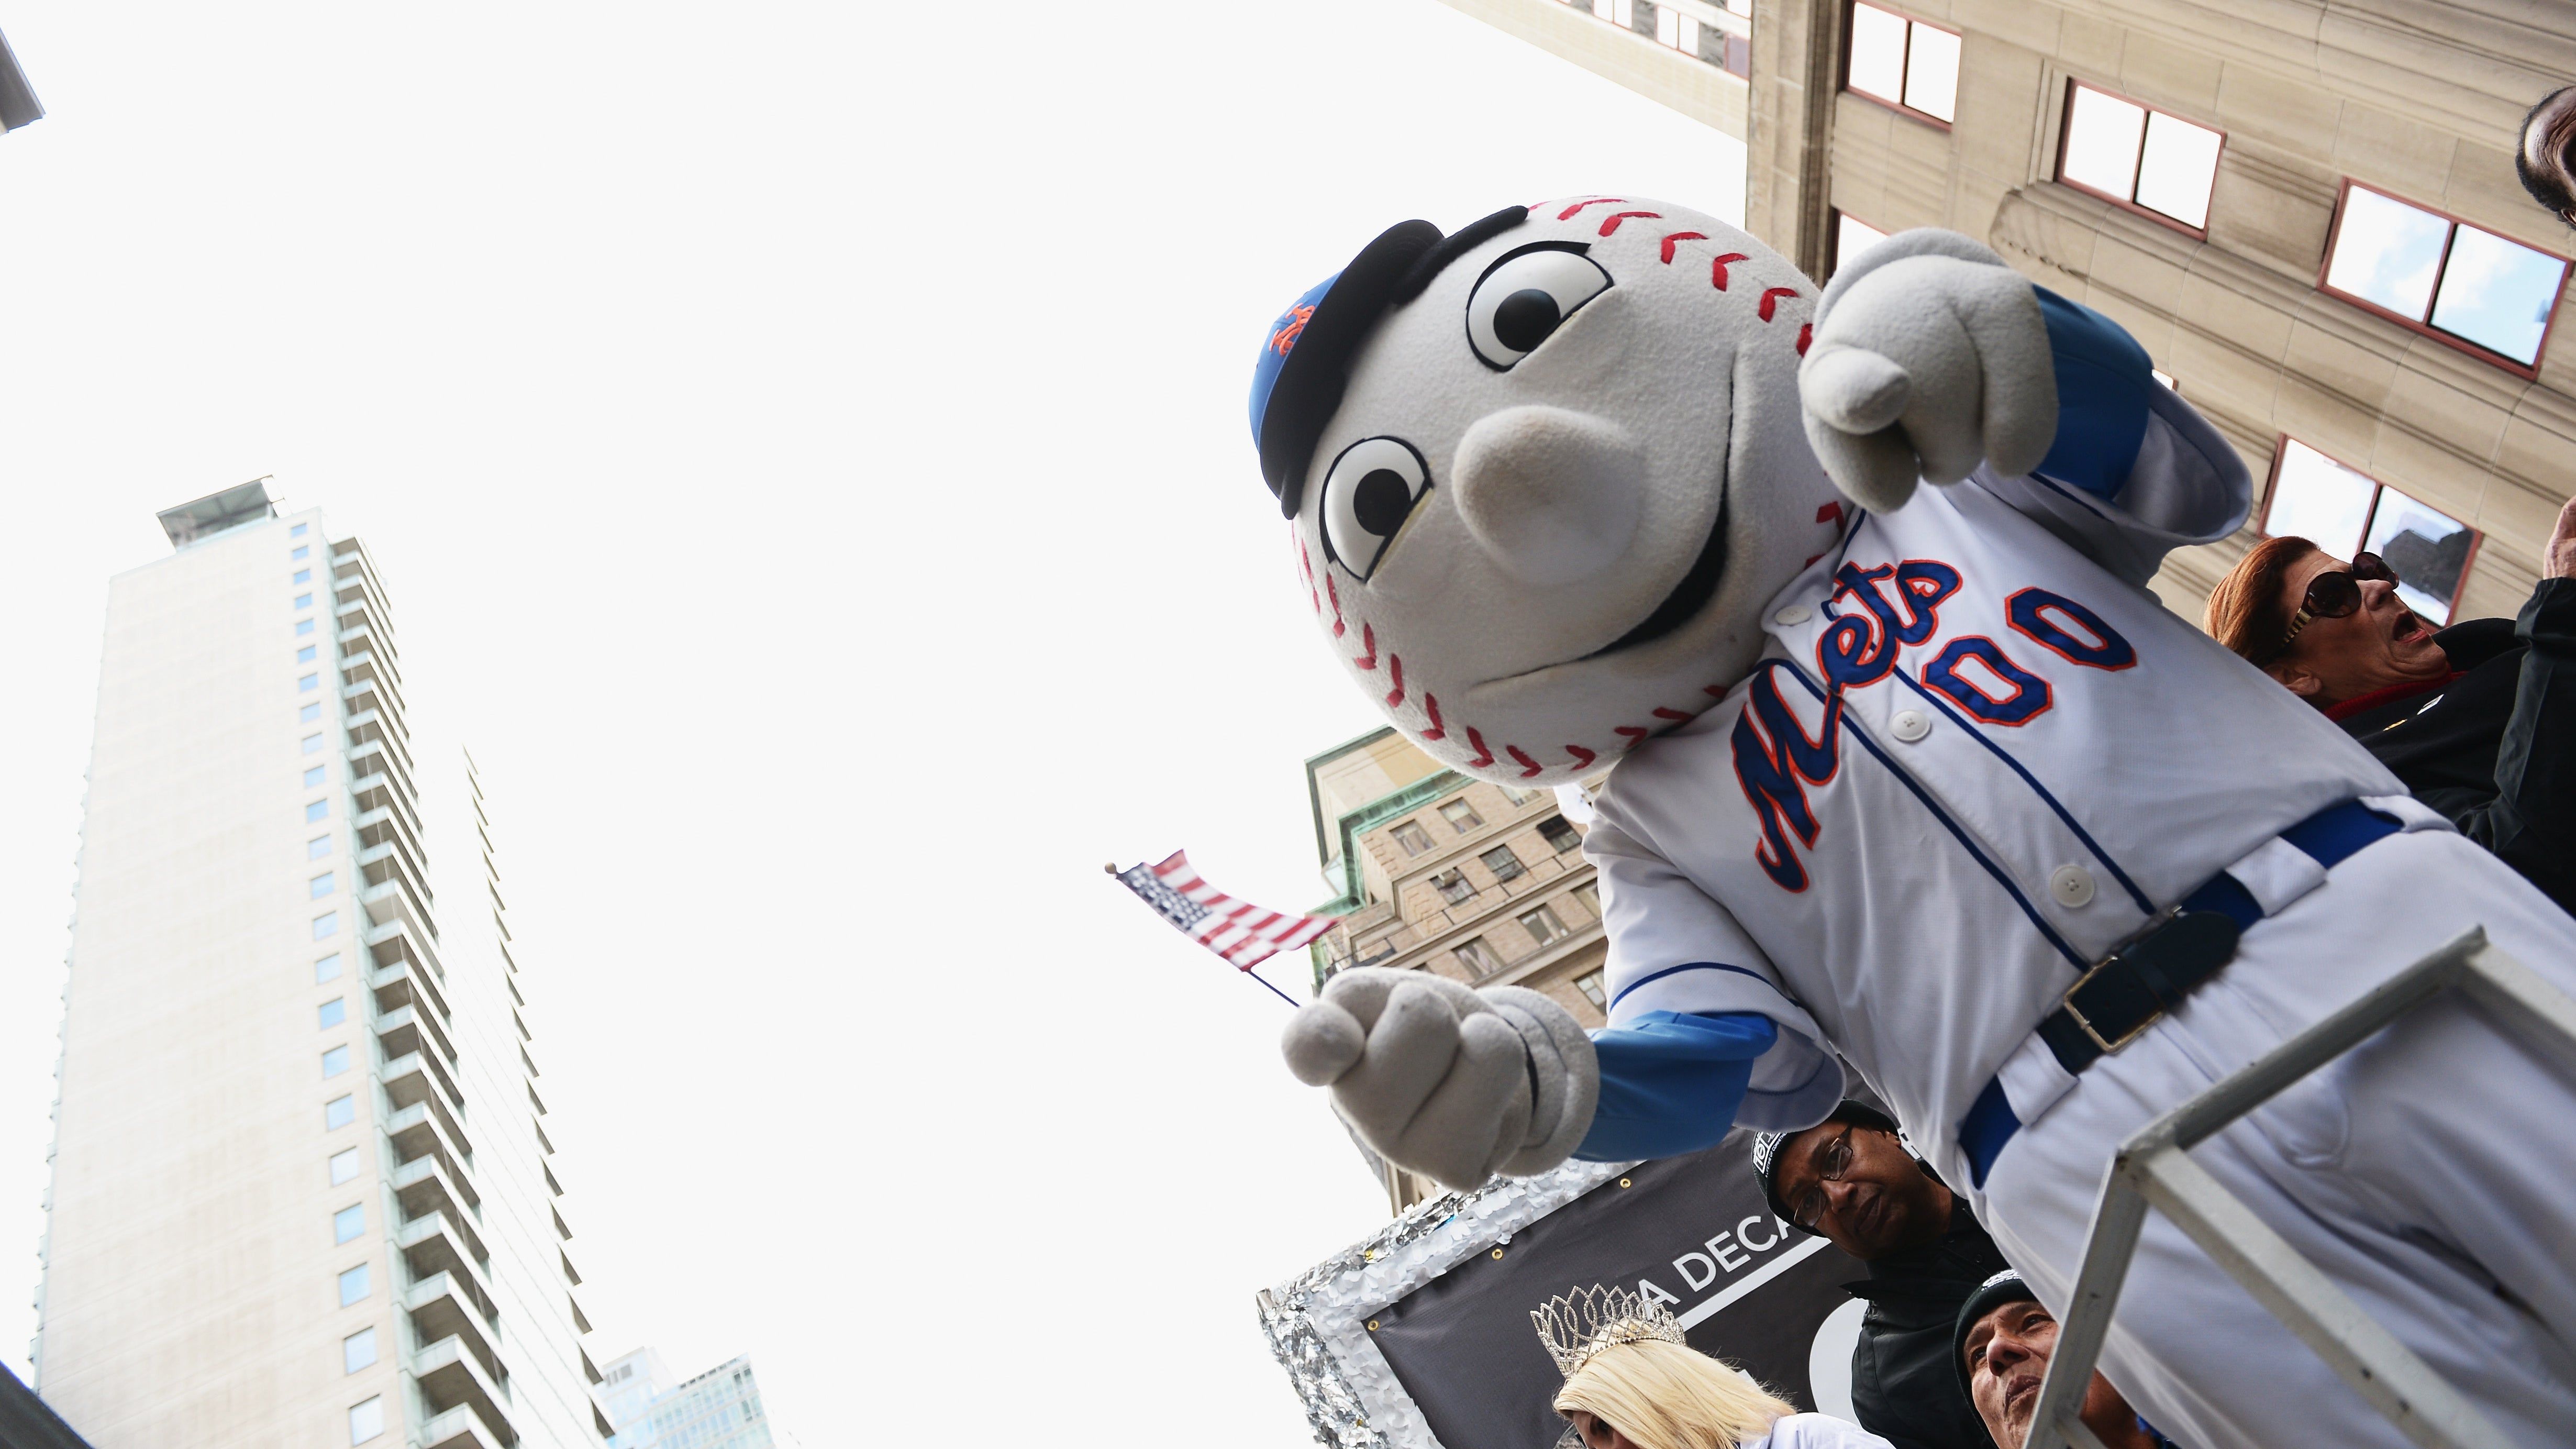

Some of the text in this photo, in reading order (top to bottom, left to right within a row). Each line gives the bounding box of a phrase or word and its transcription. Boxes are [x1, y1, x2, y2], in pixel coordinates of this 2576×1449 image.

[1731, 559, 1963, 893] Mets
[1921, 586, 2137, 727] 00
[1638, 1279, 1681, 1321] A
